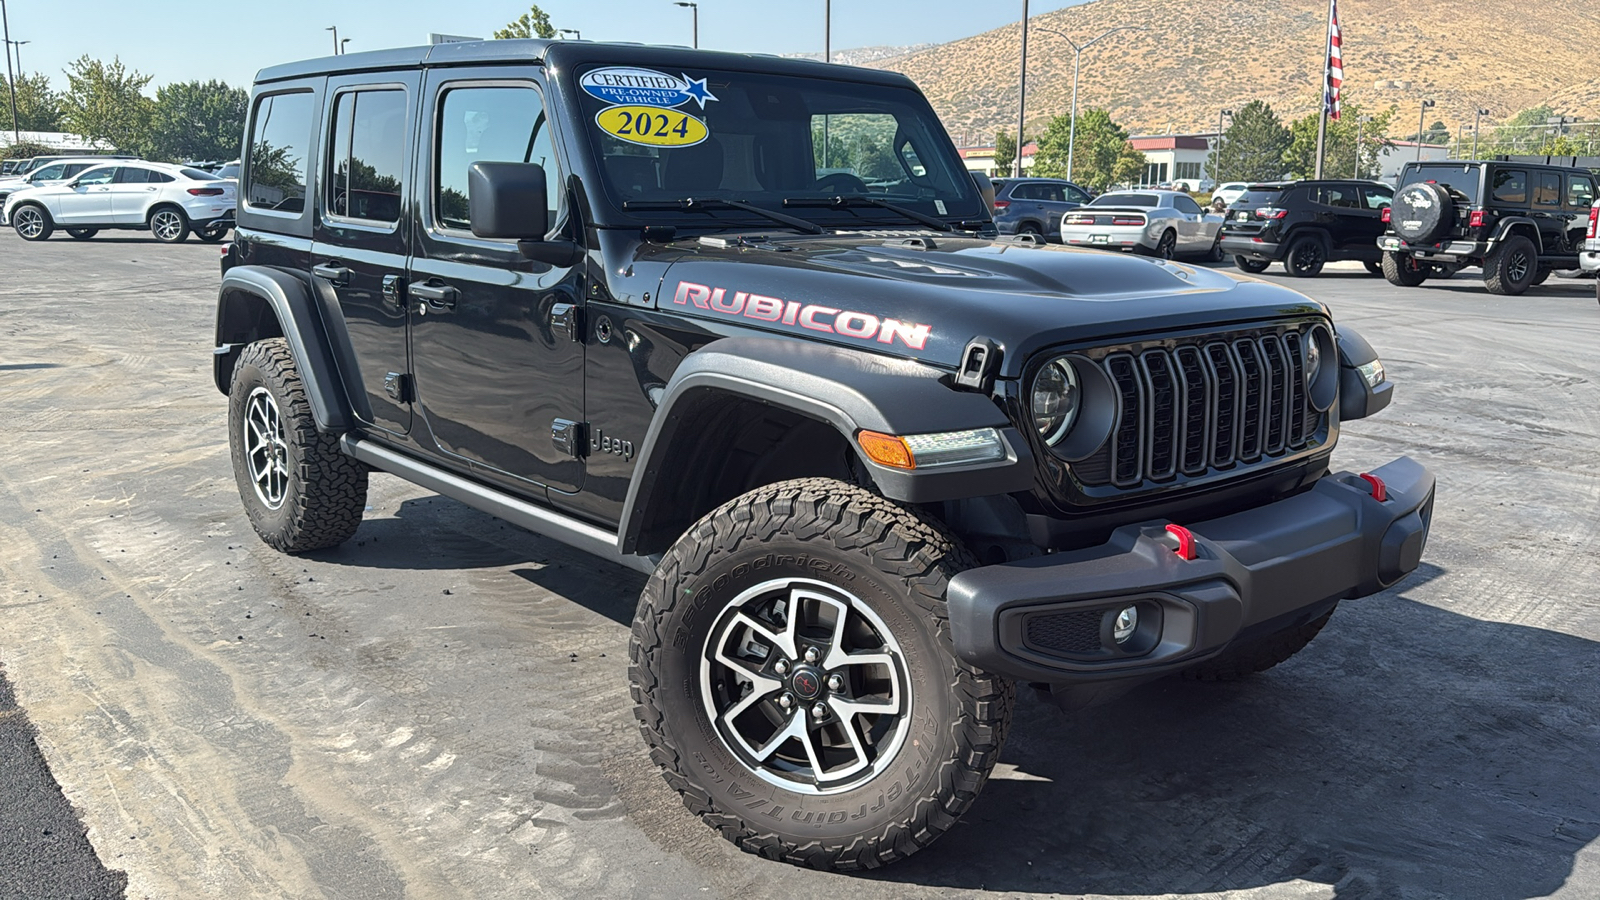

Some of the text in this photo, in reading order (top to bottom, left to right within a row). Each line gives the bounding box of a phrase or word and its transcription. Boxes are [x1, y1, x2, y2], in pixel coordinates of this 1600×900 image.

[591, 73, 677, 89] CERTIFIED
[601, 87, 678, 98] PRE-OWNED
[616, 95, 671, 104] VEHICLE
[617, 111, 689, 138] 2024
[673, 280, 932, 350] RUBICON
[590, 428, 634, 462] Jeep
[726, 781, 785, 822] T/A
